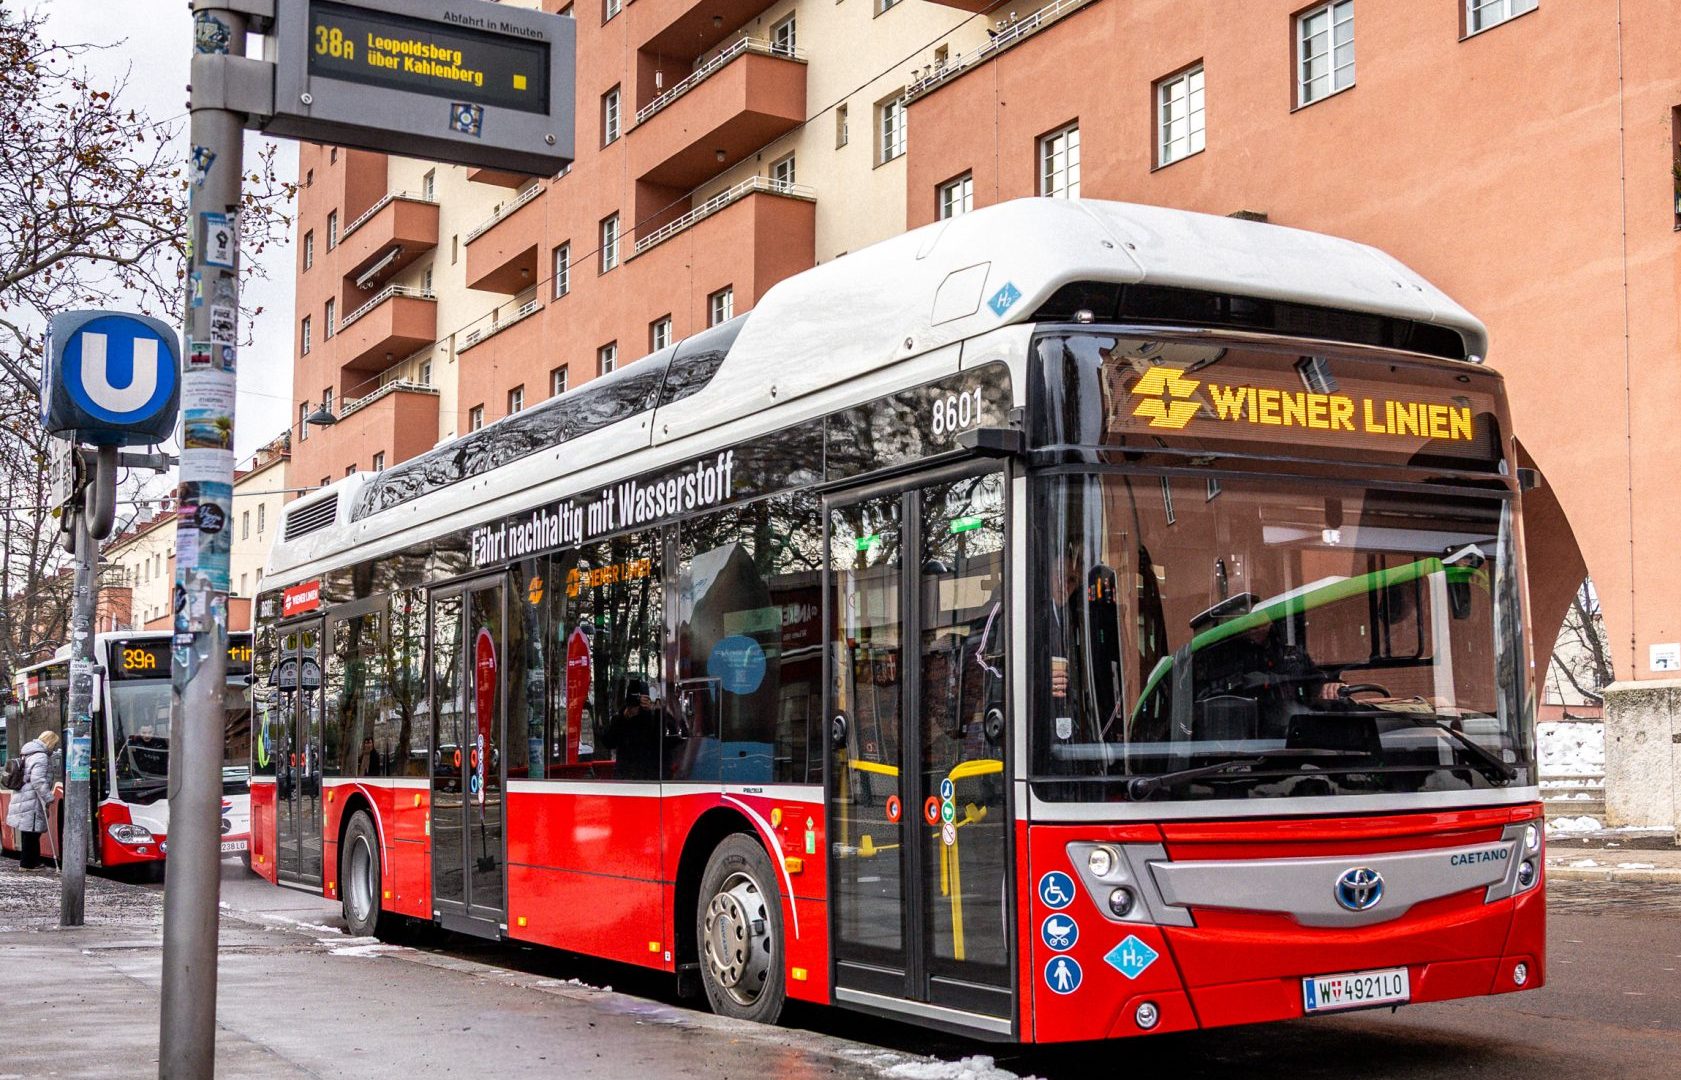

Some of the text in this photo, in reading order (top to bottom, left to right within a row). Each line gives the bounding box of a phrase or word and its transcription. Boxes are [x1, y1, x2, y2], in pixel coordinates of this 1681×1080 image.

[443, 11, 543, 39] Abfahrt in Minuten
[315, 25, 461, 65] 38A Leopoldsberg
[367, 50, 483, 86] über Kahlenberg
[81, 331, 158, 413] U
[932, 387, 981, 435] 8601
[1208, 384, 1472, 440] WIENER LINIEN
[472, 450, 734, 567] Fährt nachhaltig mit Wasserstoff
[123, 649, 156, 669] 39A
[1450, 849, 1508, 866] CAETANO
[1123, 949, 1144, 967] H2
[1320, 982, 1331, 1003] W
[1345, 974, 1402, 1000] 4921LO
